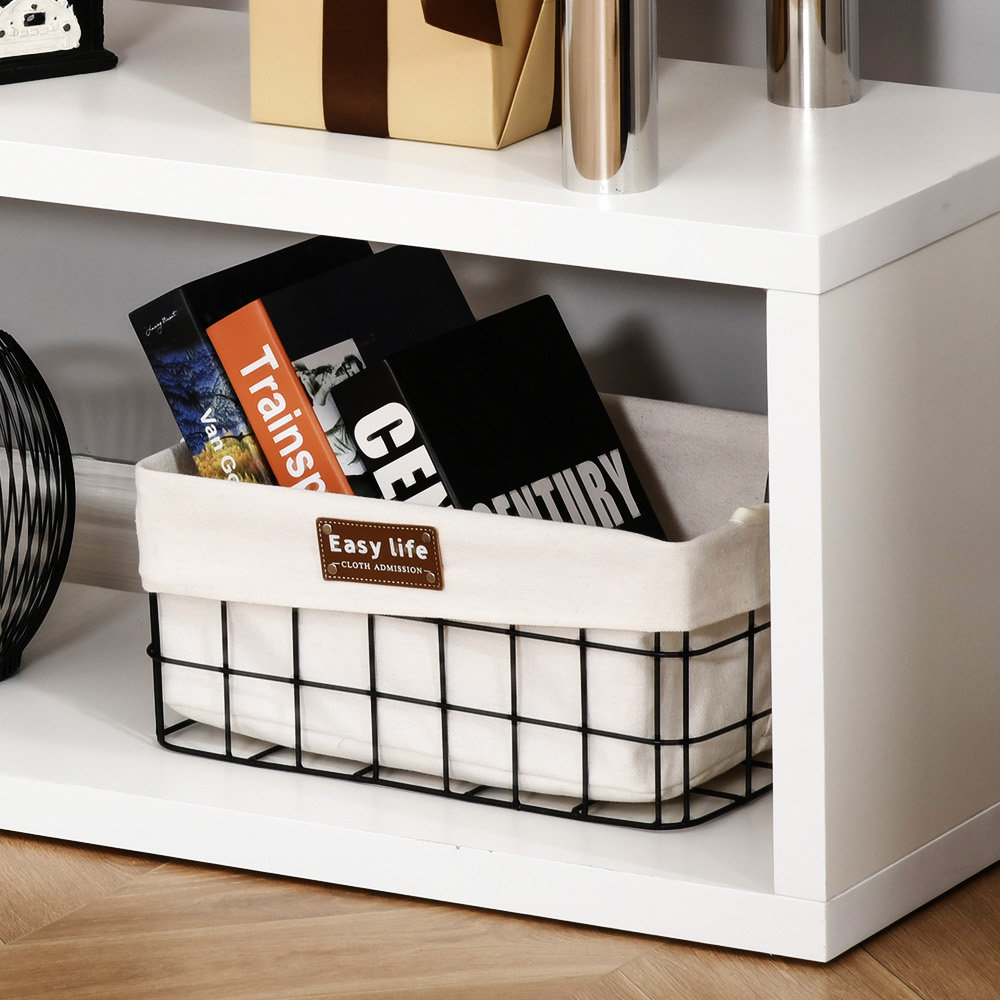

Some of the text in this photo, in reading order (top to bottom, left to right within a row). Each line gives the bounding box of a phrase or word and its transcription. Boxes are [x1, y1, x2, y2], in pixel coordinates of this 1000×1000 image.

[200, 407, 223, 452] Van
[328, 534, 429, 560] Easy life
[341, 561, 423, 575] CLOTH ADMISSION
